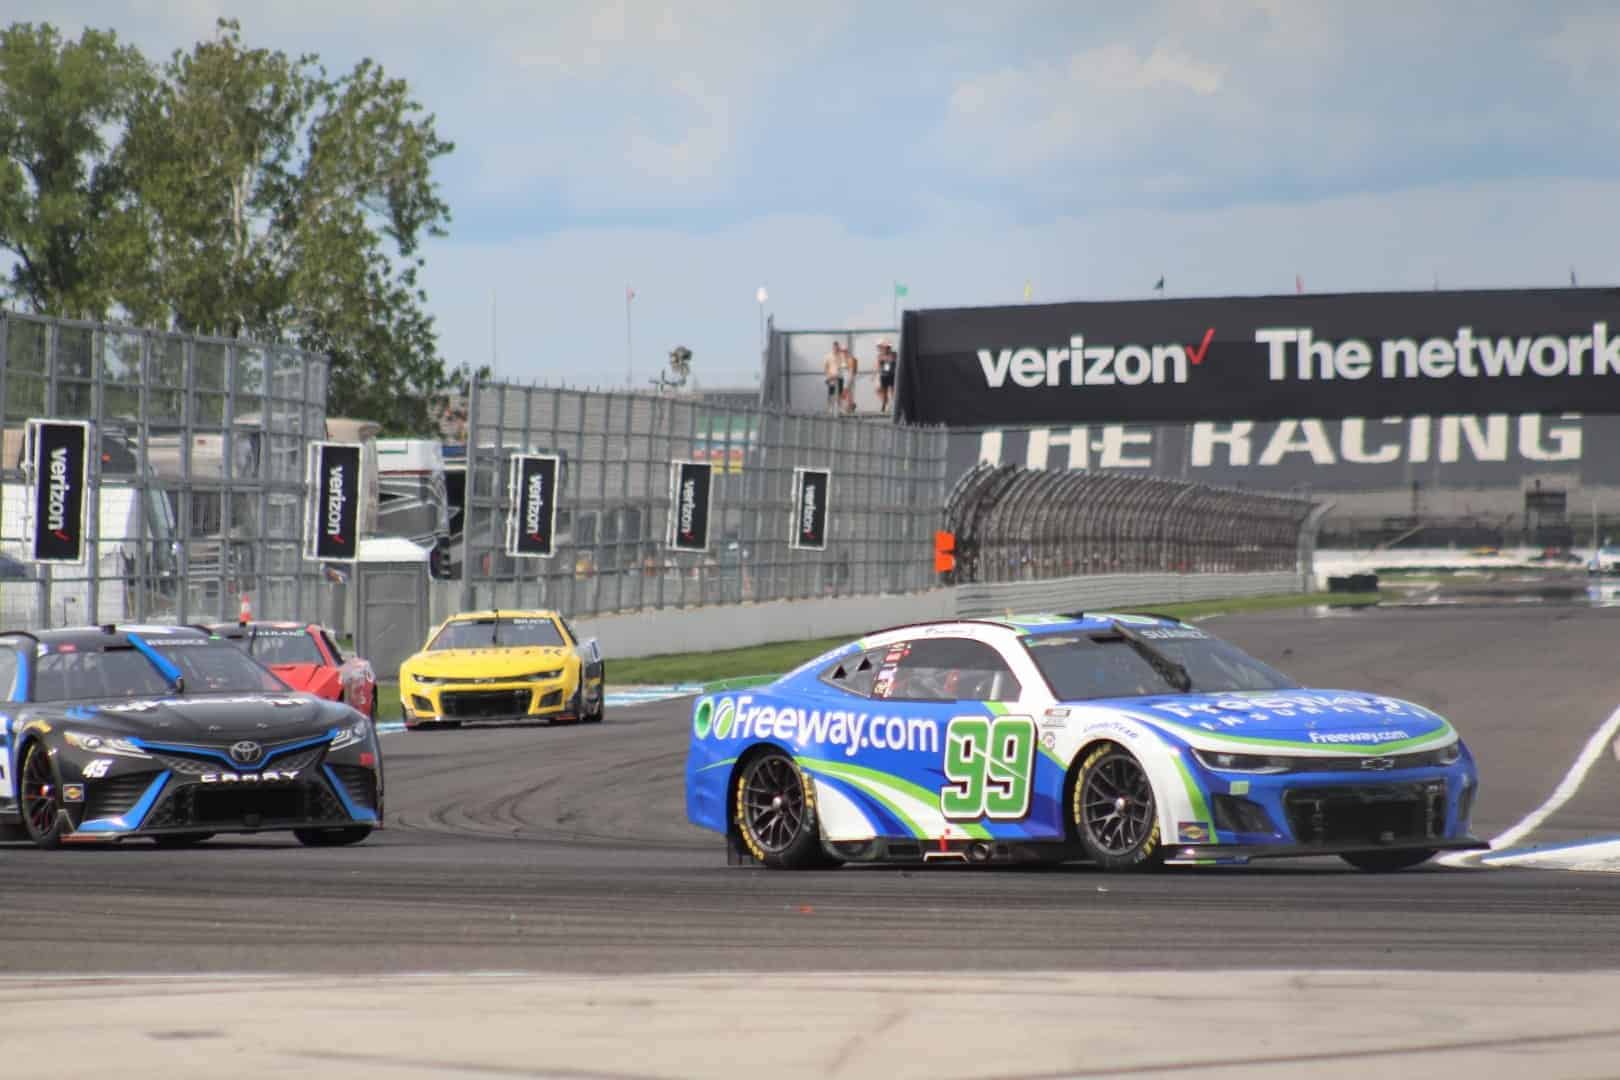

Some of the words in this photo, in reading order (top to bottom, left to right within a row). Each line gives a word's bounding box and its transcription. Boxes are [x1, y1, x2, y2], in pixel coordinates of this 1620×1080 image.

[976, 334, 1188, 388] verizon
[1255, 327, 1372, 381] The
[1380, 322, 1620, 378] network
[1191, 412, 1583, 467] RACING
[47, 446, 71, 531] verizon
[326, 464, 346, 536] verizon
[525, 473, 544, 535] verizon
[681, 479, 696, 534] verizon
[731, 696, 939, 757] Freeway.com
[1308, 730, 1409, 745] Freeway.com
[82, 759, 113, 779] 45
[200, 769, 300, 783] CAMRY
[940, 715, 1035, 819] 99
